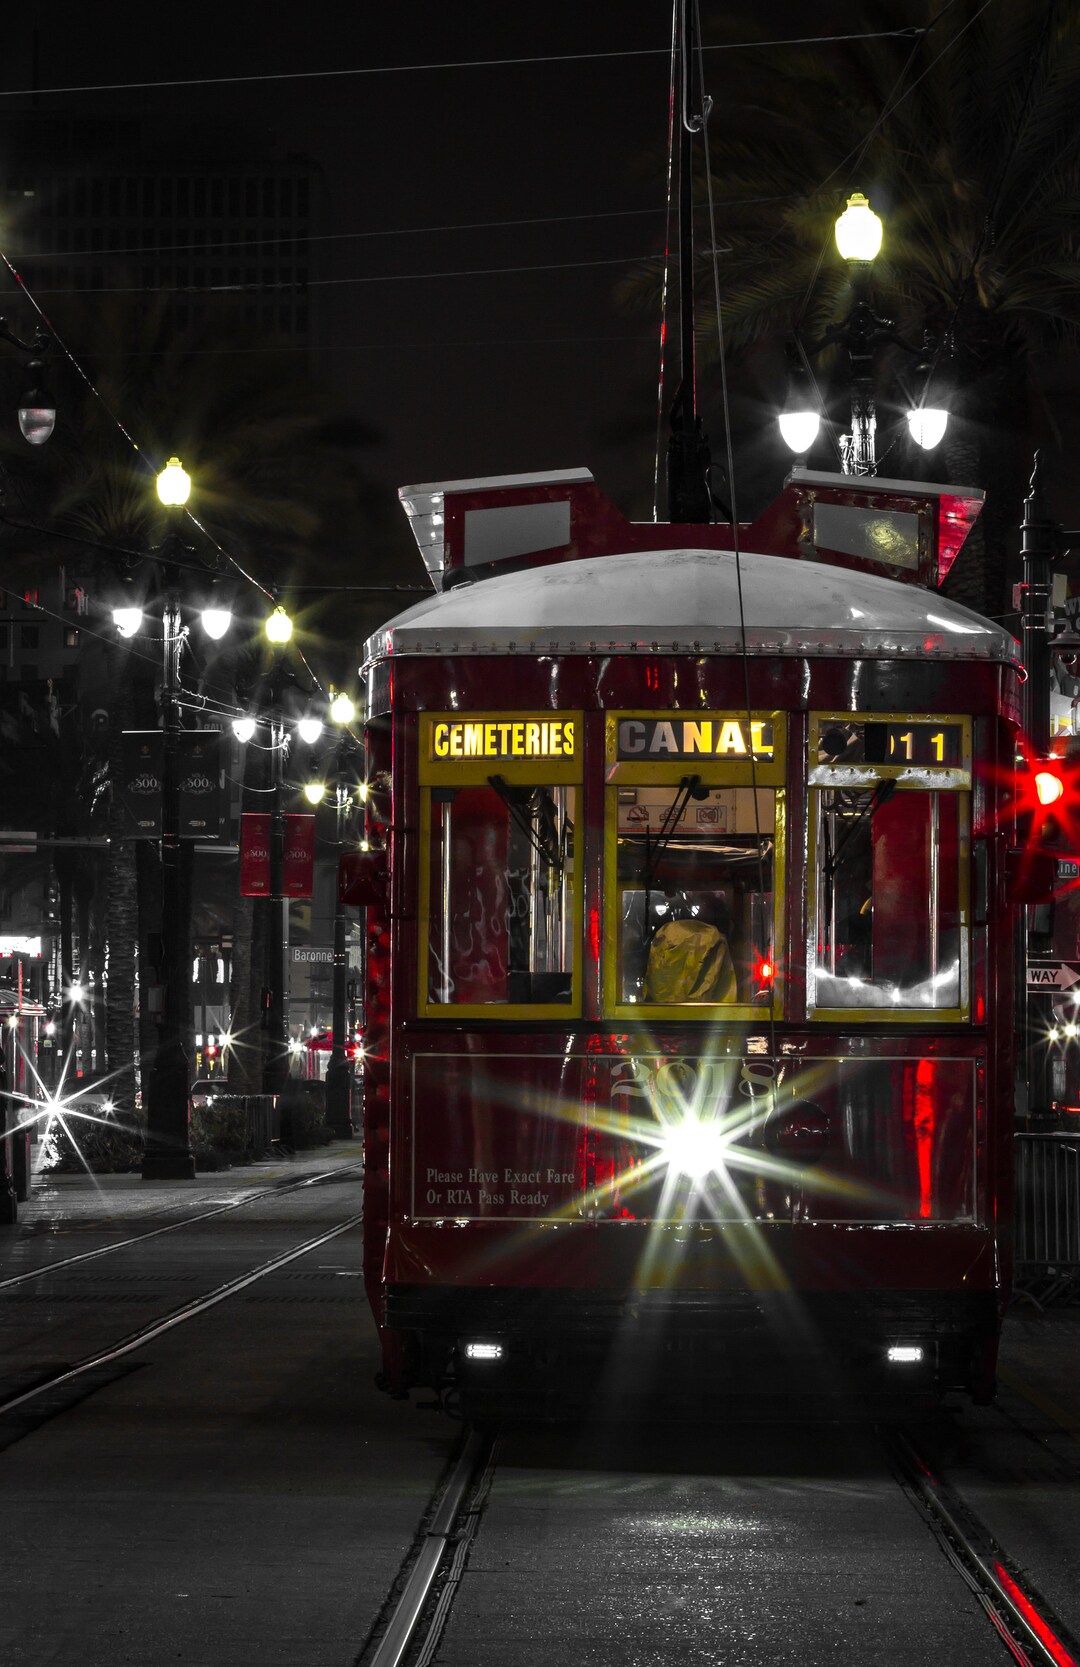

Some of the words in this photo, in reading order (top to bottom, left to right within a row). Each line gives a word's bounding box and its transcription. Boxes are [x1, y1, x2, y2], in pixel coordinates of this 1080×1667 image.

[435, 722, 574, 756] CEMETERIES
[619, 721, 774, 753] CANAL
[294, 949, 333, 961] Baronne
[1031, 970, 1059, 983] WAY
[426, 1168, 463, 1183] Please
[469, 1168, 499, 1183] Have
[504, 1168, 541, 1183] Exact
[547, 1168, 575, 1184] Fare
[426, 1189, 442, 1204] Or
[447, 1189, 473, 1204] RTA
[478, 1189, 505, 1205] Pass
[510, 1189, 550, 1207] Ready
